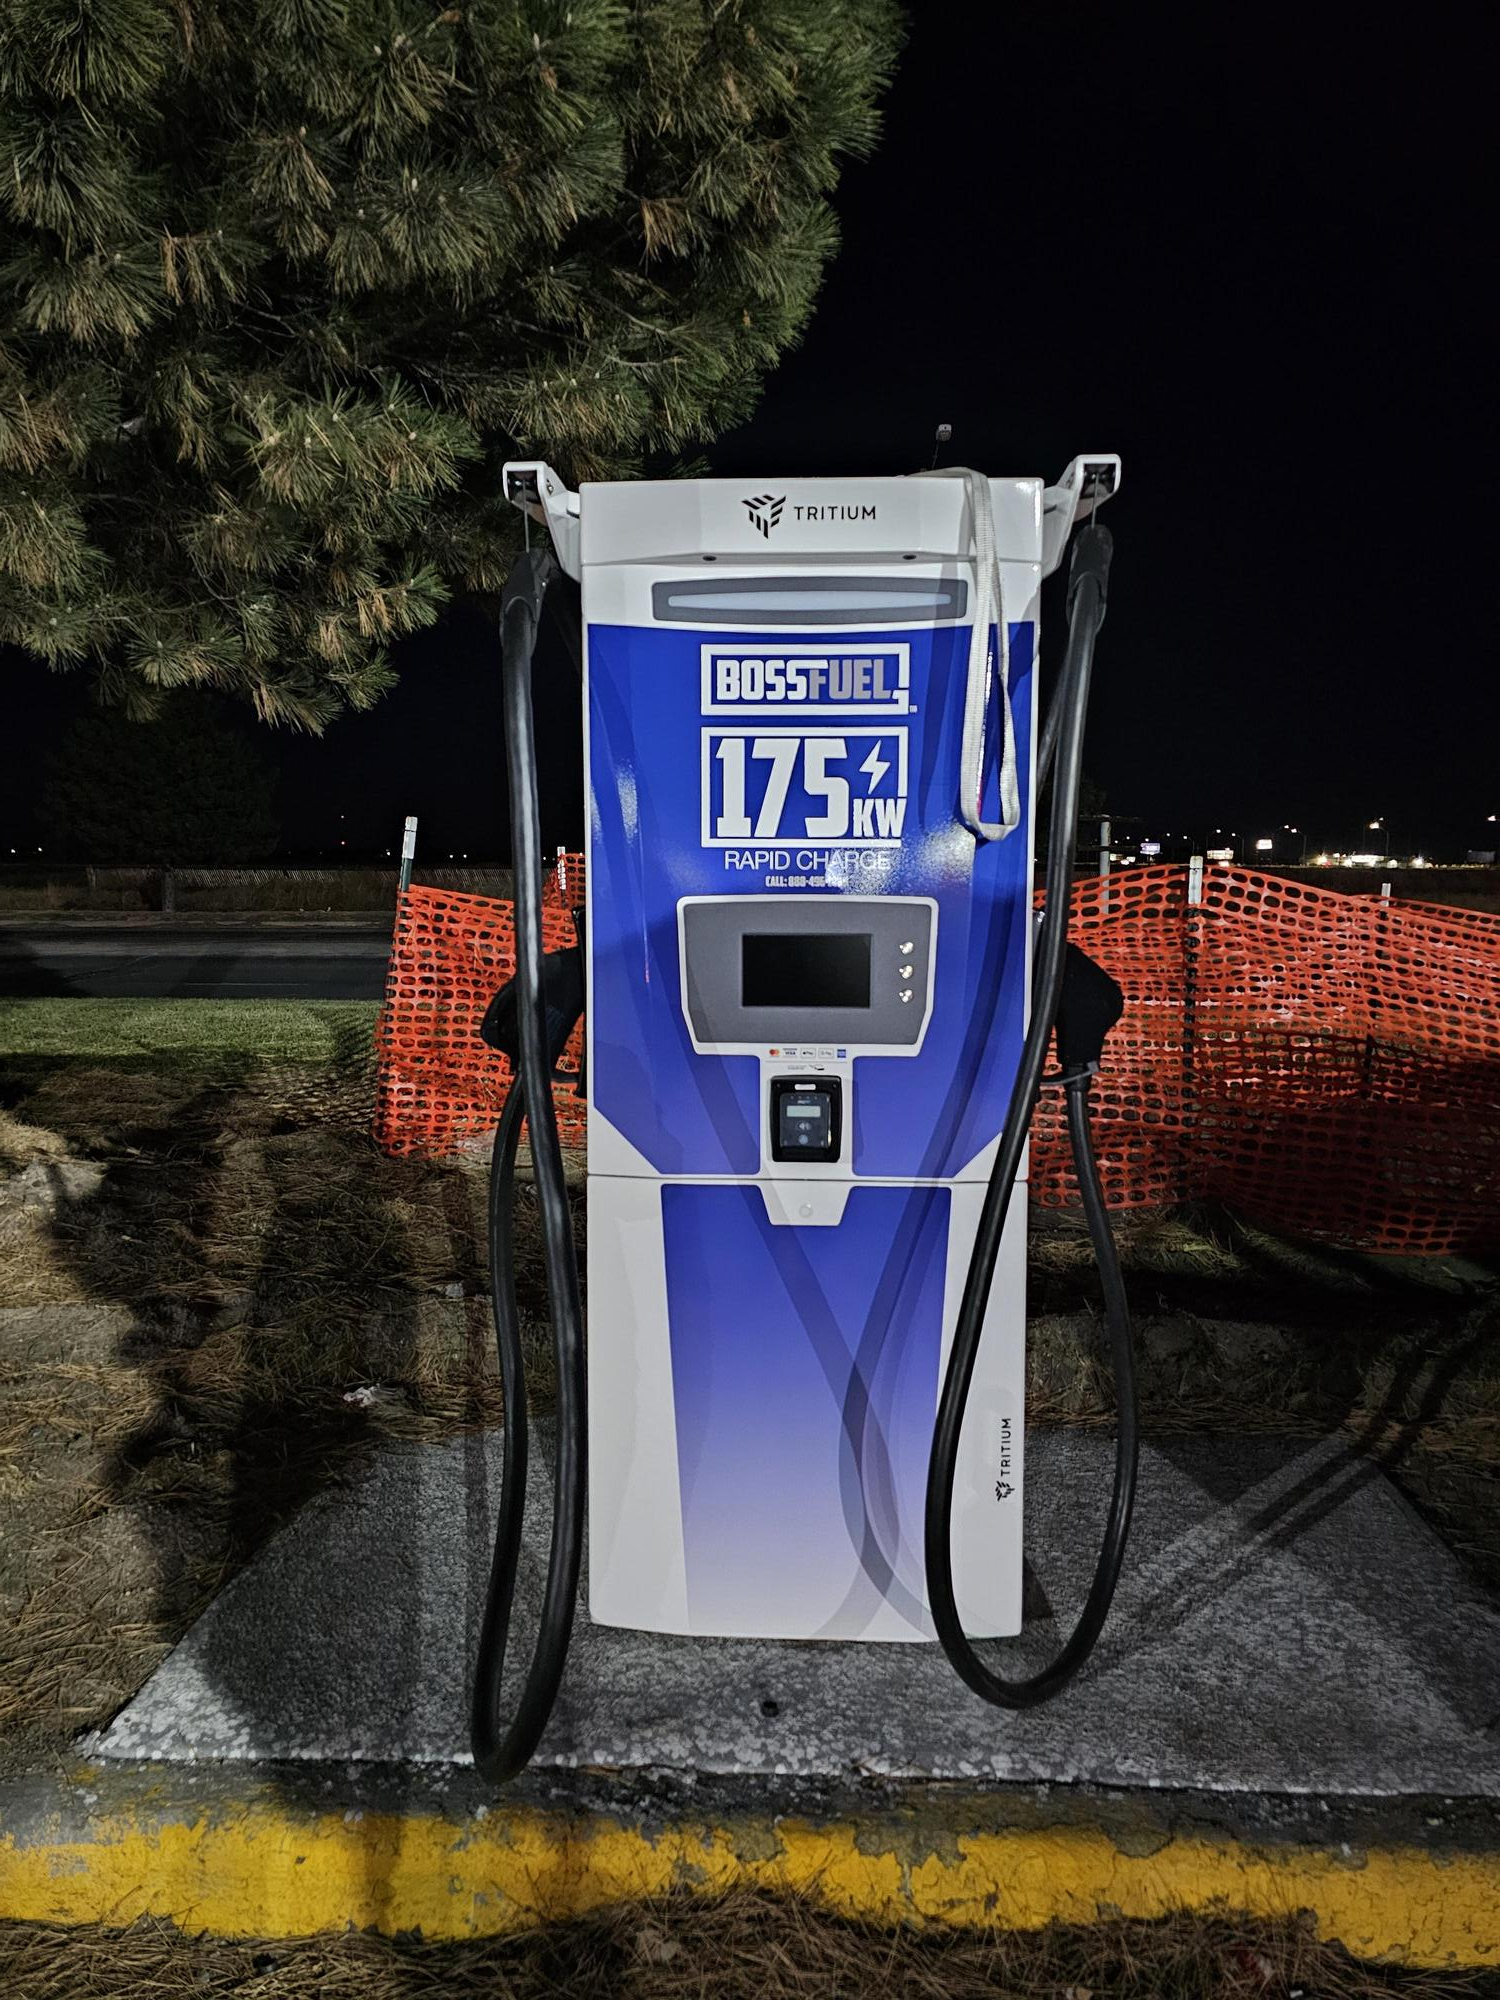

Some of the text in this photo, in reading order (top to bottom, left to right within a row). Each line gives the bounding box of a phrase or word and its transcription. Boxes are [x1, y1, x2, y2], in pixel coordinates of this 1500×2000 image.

[793, 505, 877, 521] TRITIUM
[715, 738, 908, 838] 175 KW
[724, 850, 891, 872] RAPID CHARGE
[765, 875, 788, 888] CALL:
[1000, 1417, 1012, 1478] TRITIUM
